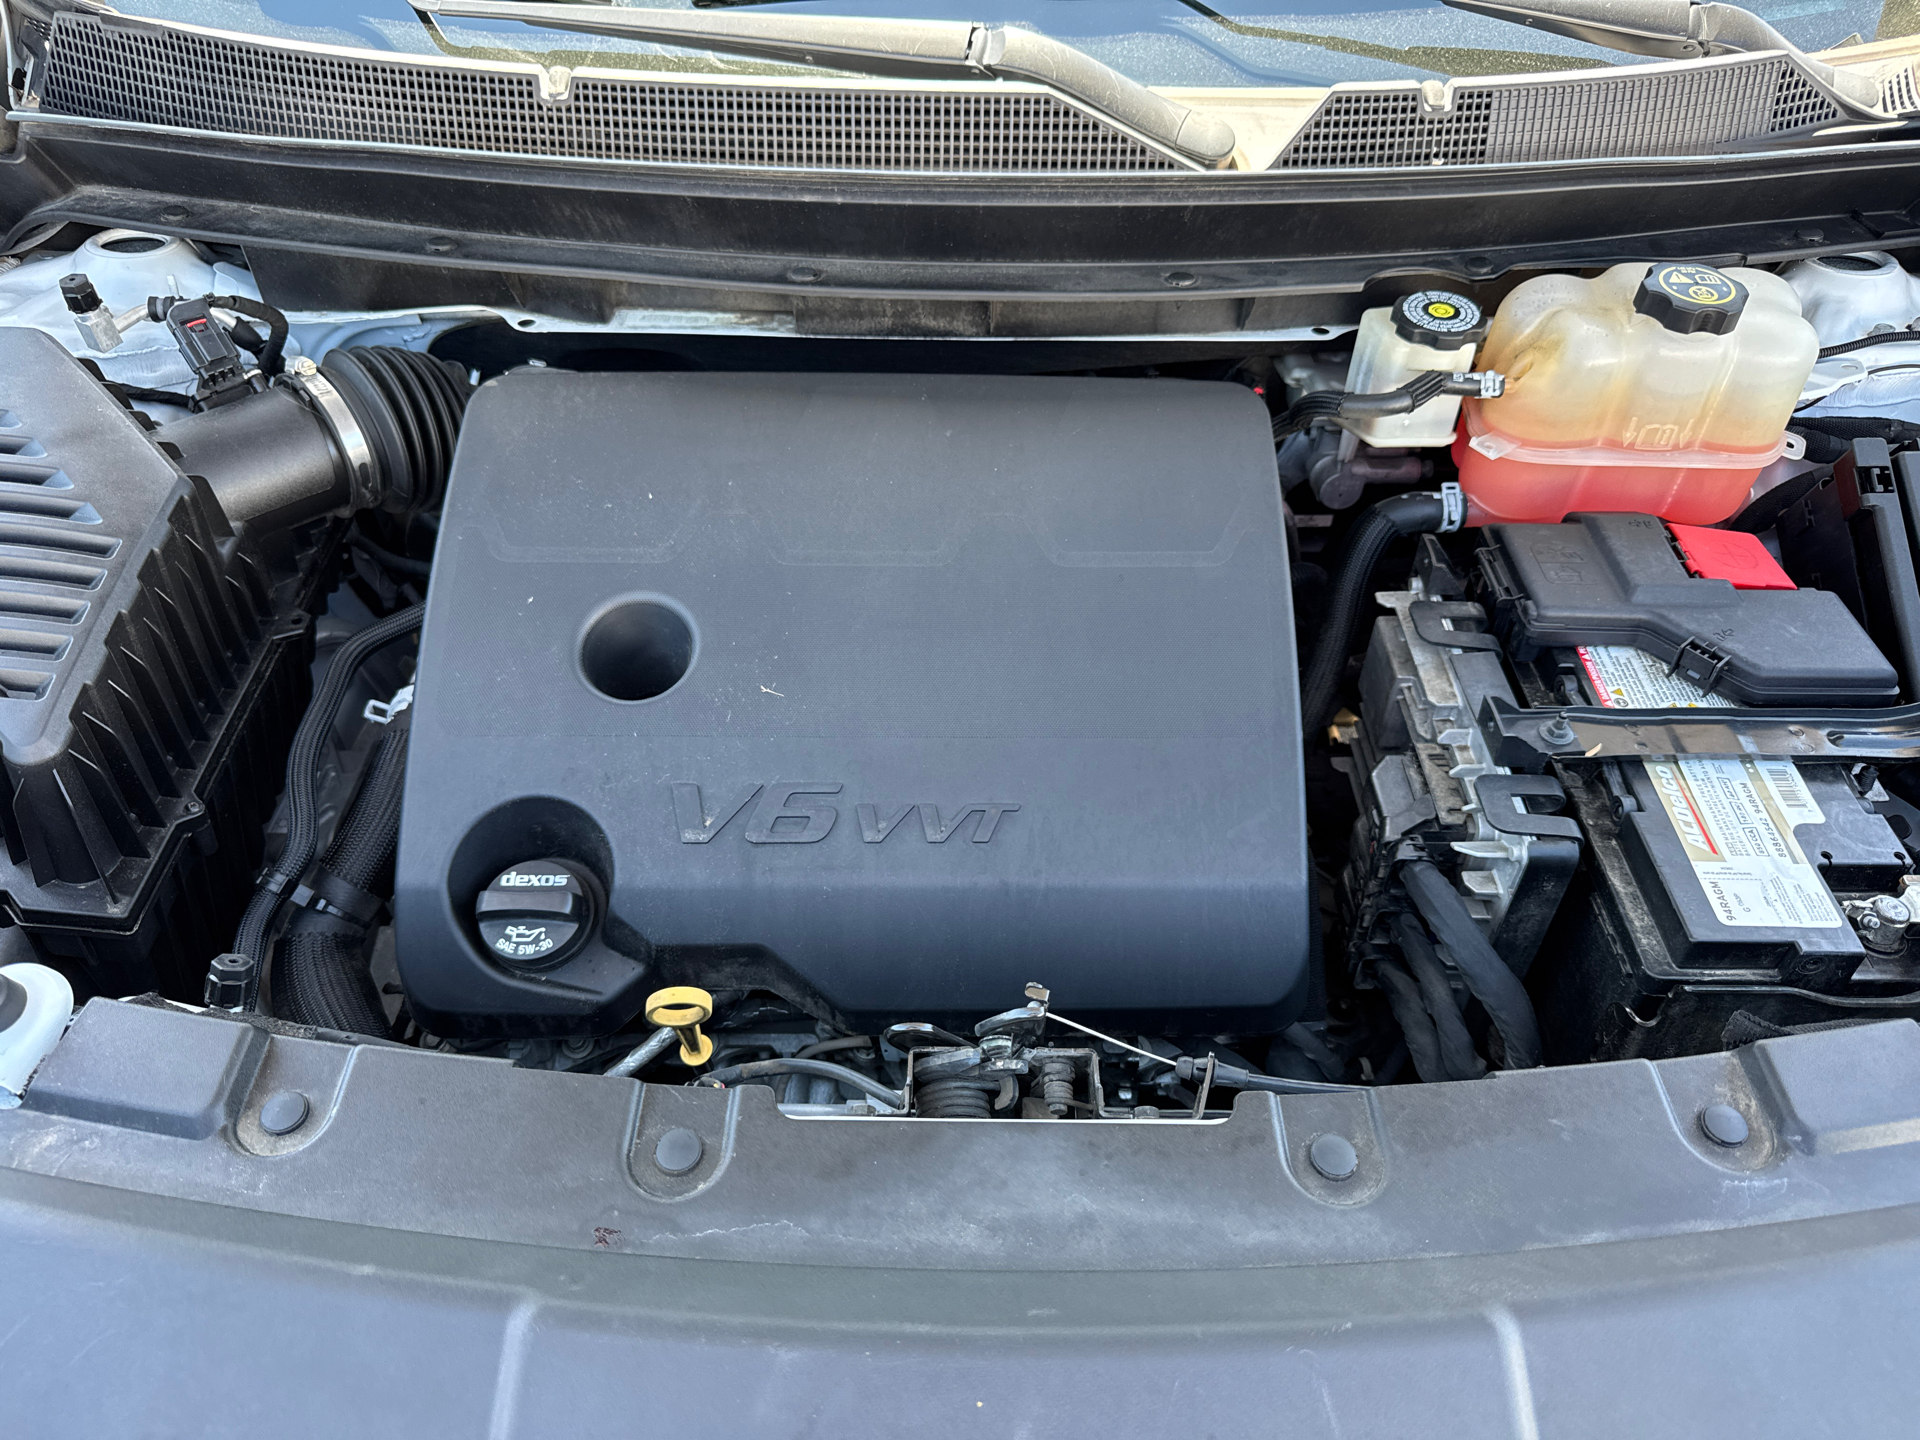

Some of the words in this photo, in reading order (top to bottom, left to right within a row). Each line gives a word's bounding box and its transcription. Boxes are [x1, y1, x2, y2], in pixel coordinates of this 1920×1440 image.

[671, 782, 843, 844] V6
[856, 803, 1021, 844] VVT
[1656, 765, 1709, 851] ACDelco
[1739, 783, 1763, 814] 94RAGM
[1704, 800, 1729, 841] MAINTENANCE
[1748, 830, 1758, 842] CCA
[1759, 818, 1787, 858] 88864542
[500, 871, 568, 887] dexos
[1709, 881, 1736, 921] 94RAGM
[495, 938, 516, 954] SAE
[517, 938, 554, 955] 5W-30
